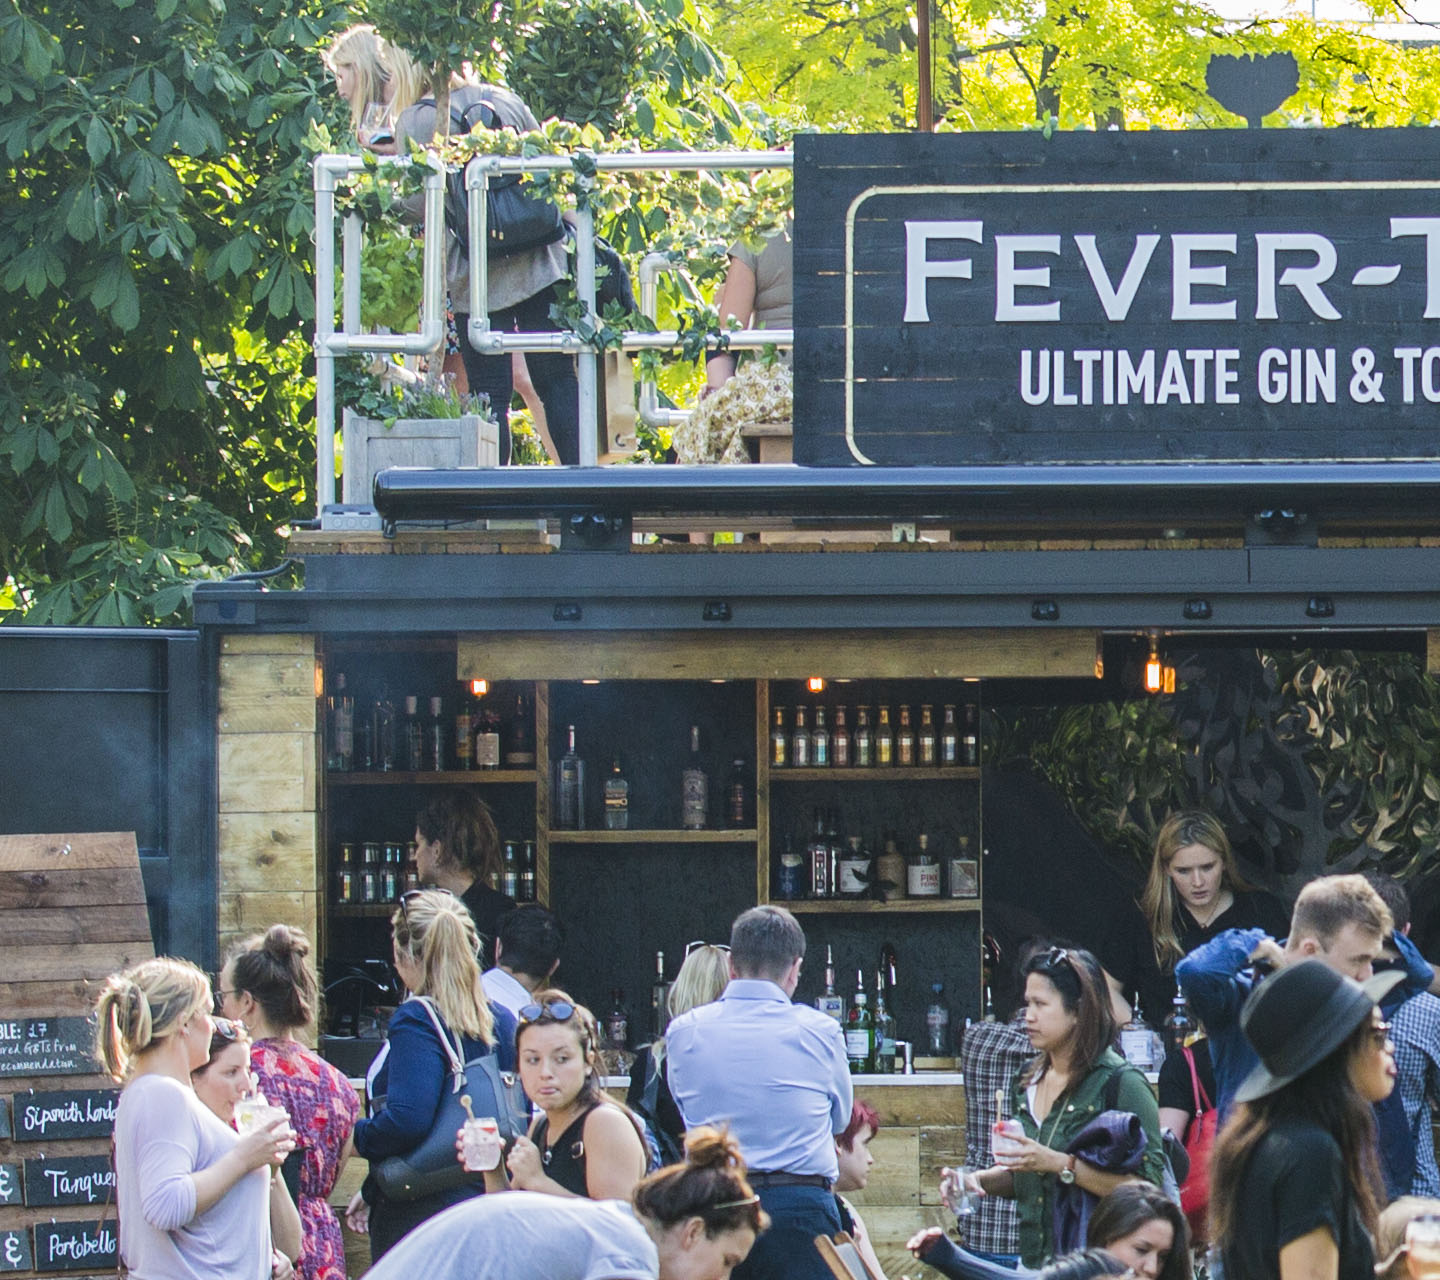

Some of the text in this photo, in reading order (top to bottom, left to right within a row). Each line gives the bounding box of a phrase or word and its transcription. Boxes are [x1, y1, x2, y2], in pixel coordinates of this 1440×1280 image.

[1019, 349, 1241, 406] ULTIMATE
[1257, 347, 1337, 404] GIN
[1348, 347, 1386, 404] &
[27, 1022, 48, 1038] £7
[24, 1098, 119, 1134] Sipsmith Londo
[48, 1230, 118, 1262] Portobello
